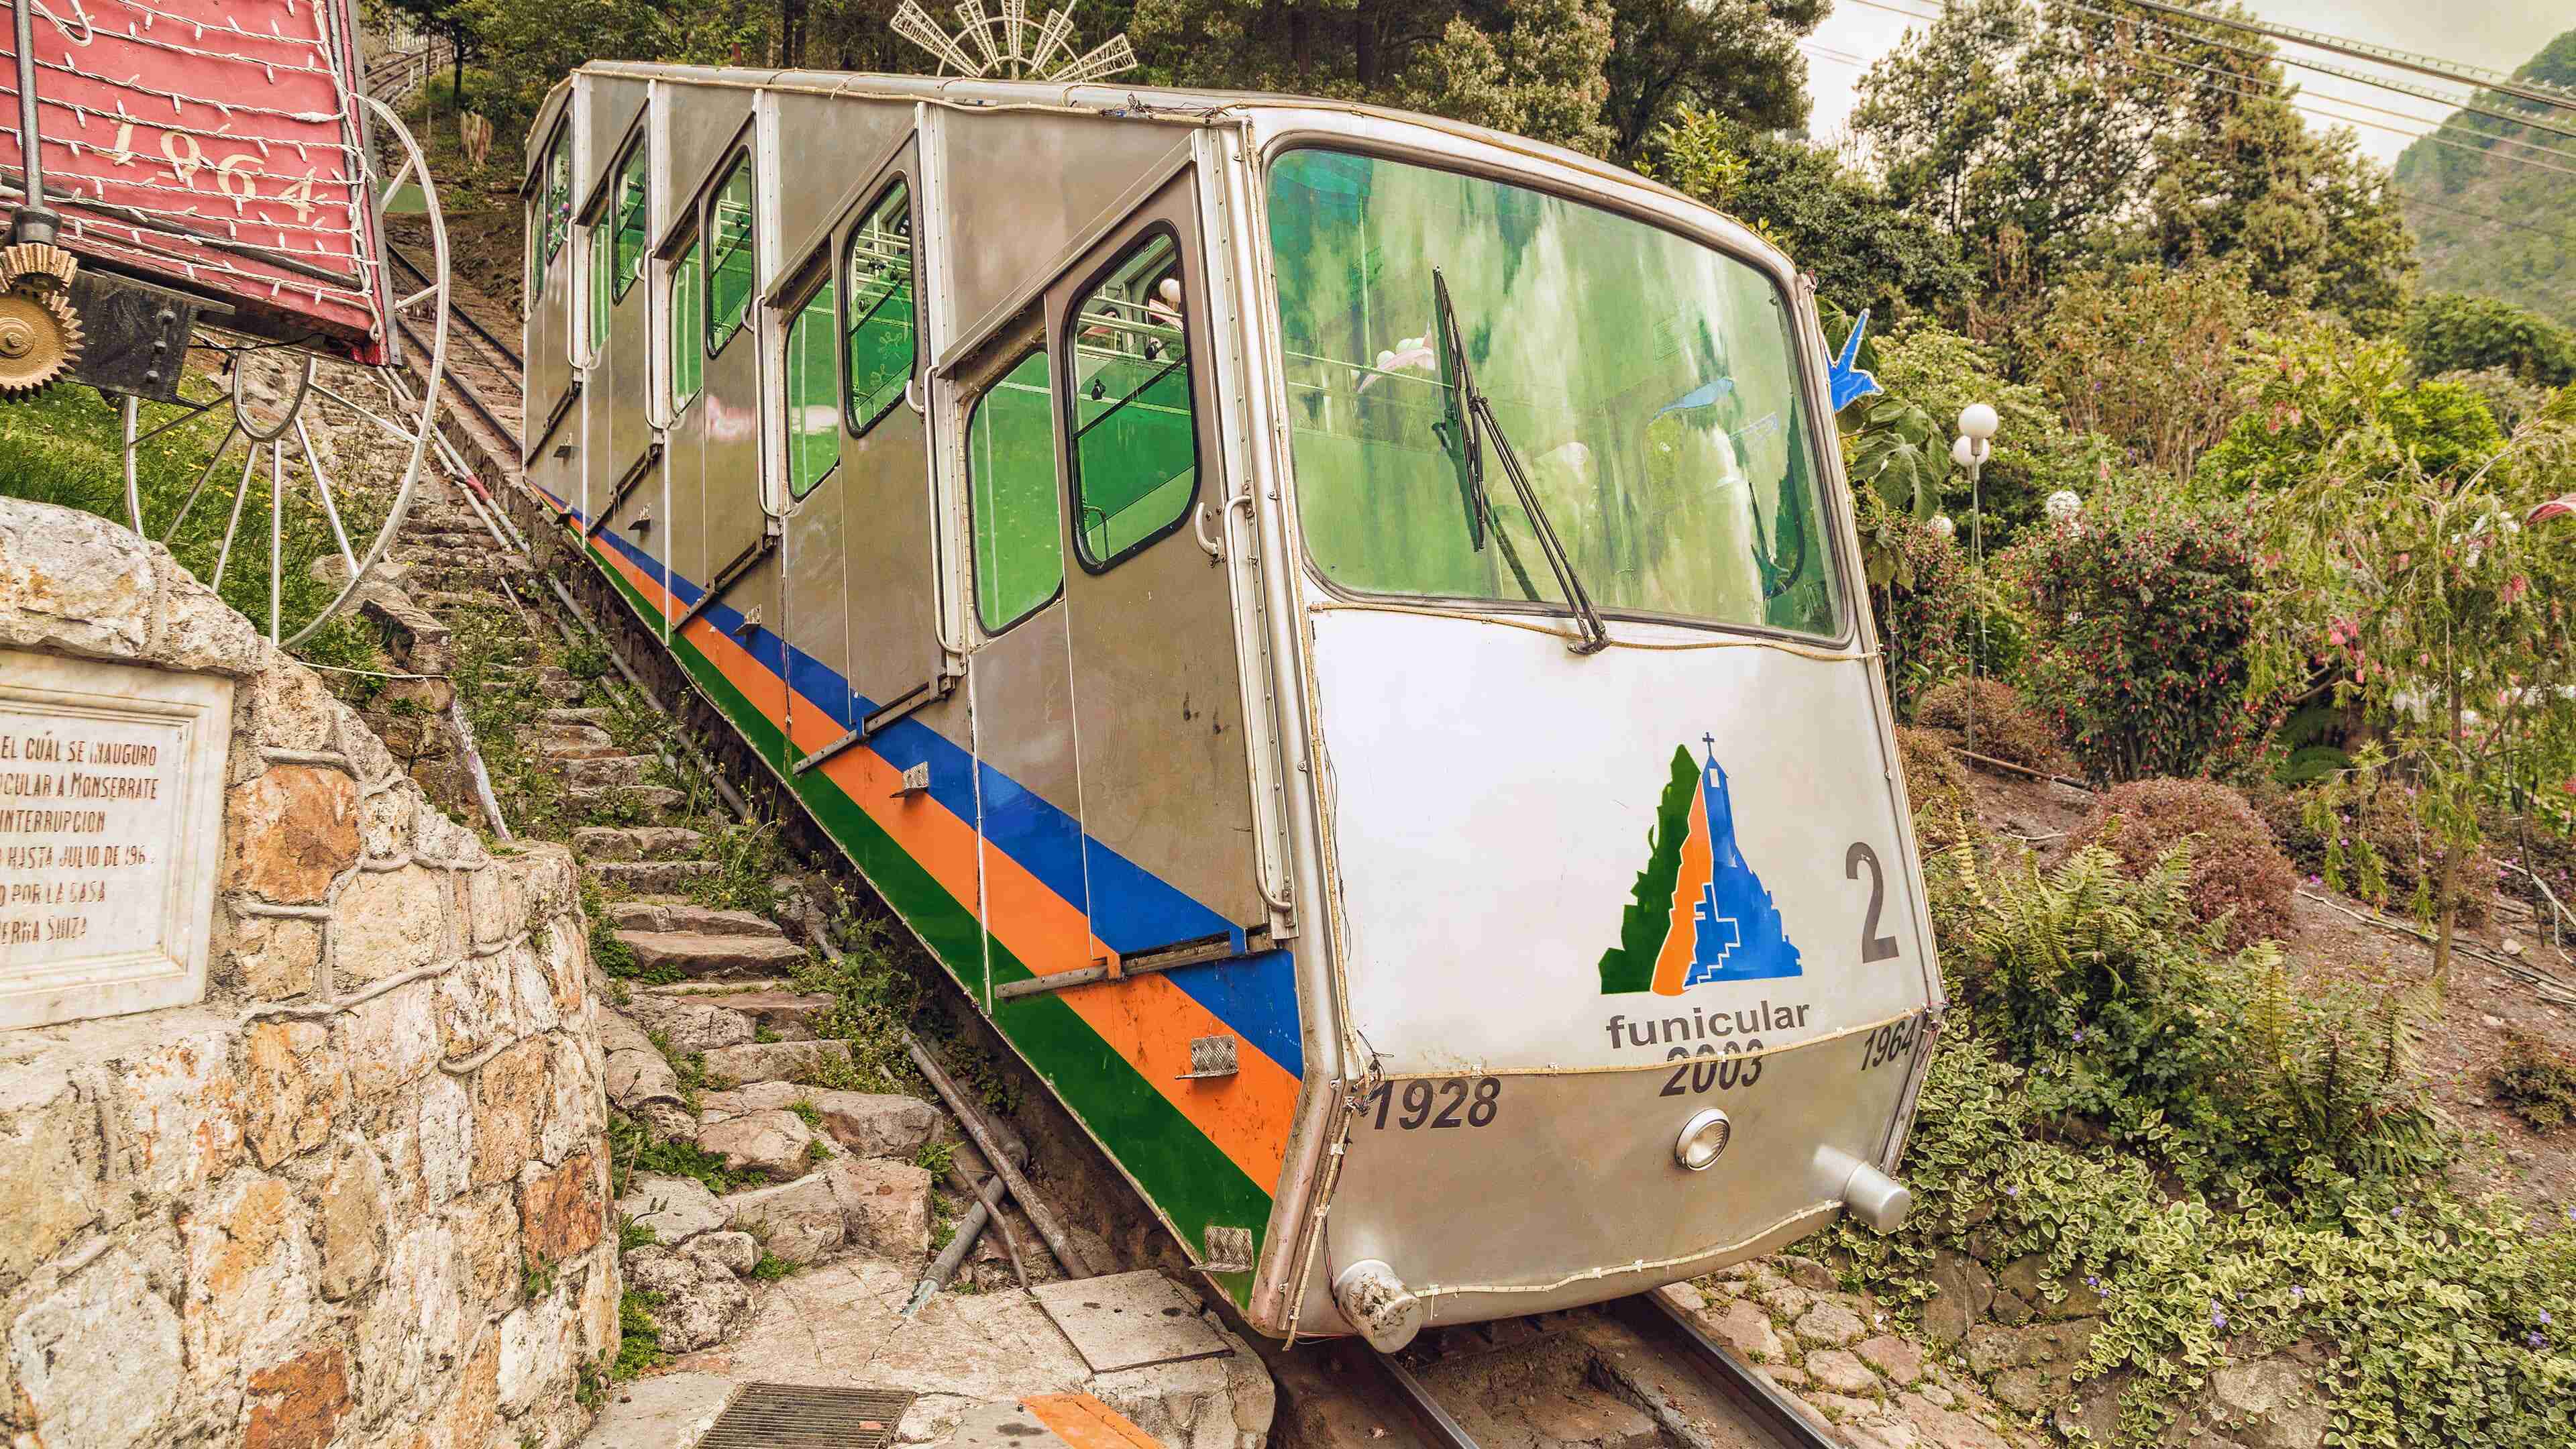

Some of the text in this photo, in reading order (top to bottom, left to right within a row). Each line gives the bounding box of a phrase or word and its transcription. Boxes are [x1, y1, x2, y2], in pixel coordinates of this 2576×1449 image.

[93, 115, 317, 223] 1964
[1, 736, 17, 759] EL
[67, 741, 85, 763] SE
[89, 741, 157, 766] INAUGURO
[56, 775, 64, 798] A
[70, 772, 159, 800] MONSERRATE
[0, 810, 106, 833] INTERRUPCION
[8, 847, 53, 869] HASTA
[59, 845, 99, 868] JULIO
[103, 845, 120, 867] DE
[125, 844, 156, 865] 196
[11, 883, 40, 904] POR
[46, 882, 63, 904] LA
[69, 880, 105, 902] CASA
[1845, 842, 1899, 963] 2
[46, 916, 87, 941] SUIZA
[1606, 1000, 1810, 1049] funicular
[1861, 1014, 1917, 1071] 1964
[1659, 1038, 1763, 1097] 2003
[1370, 1079, 1501, 1130] 1928
